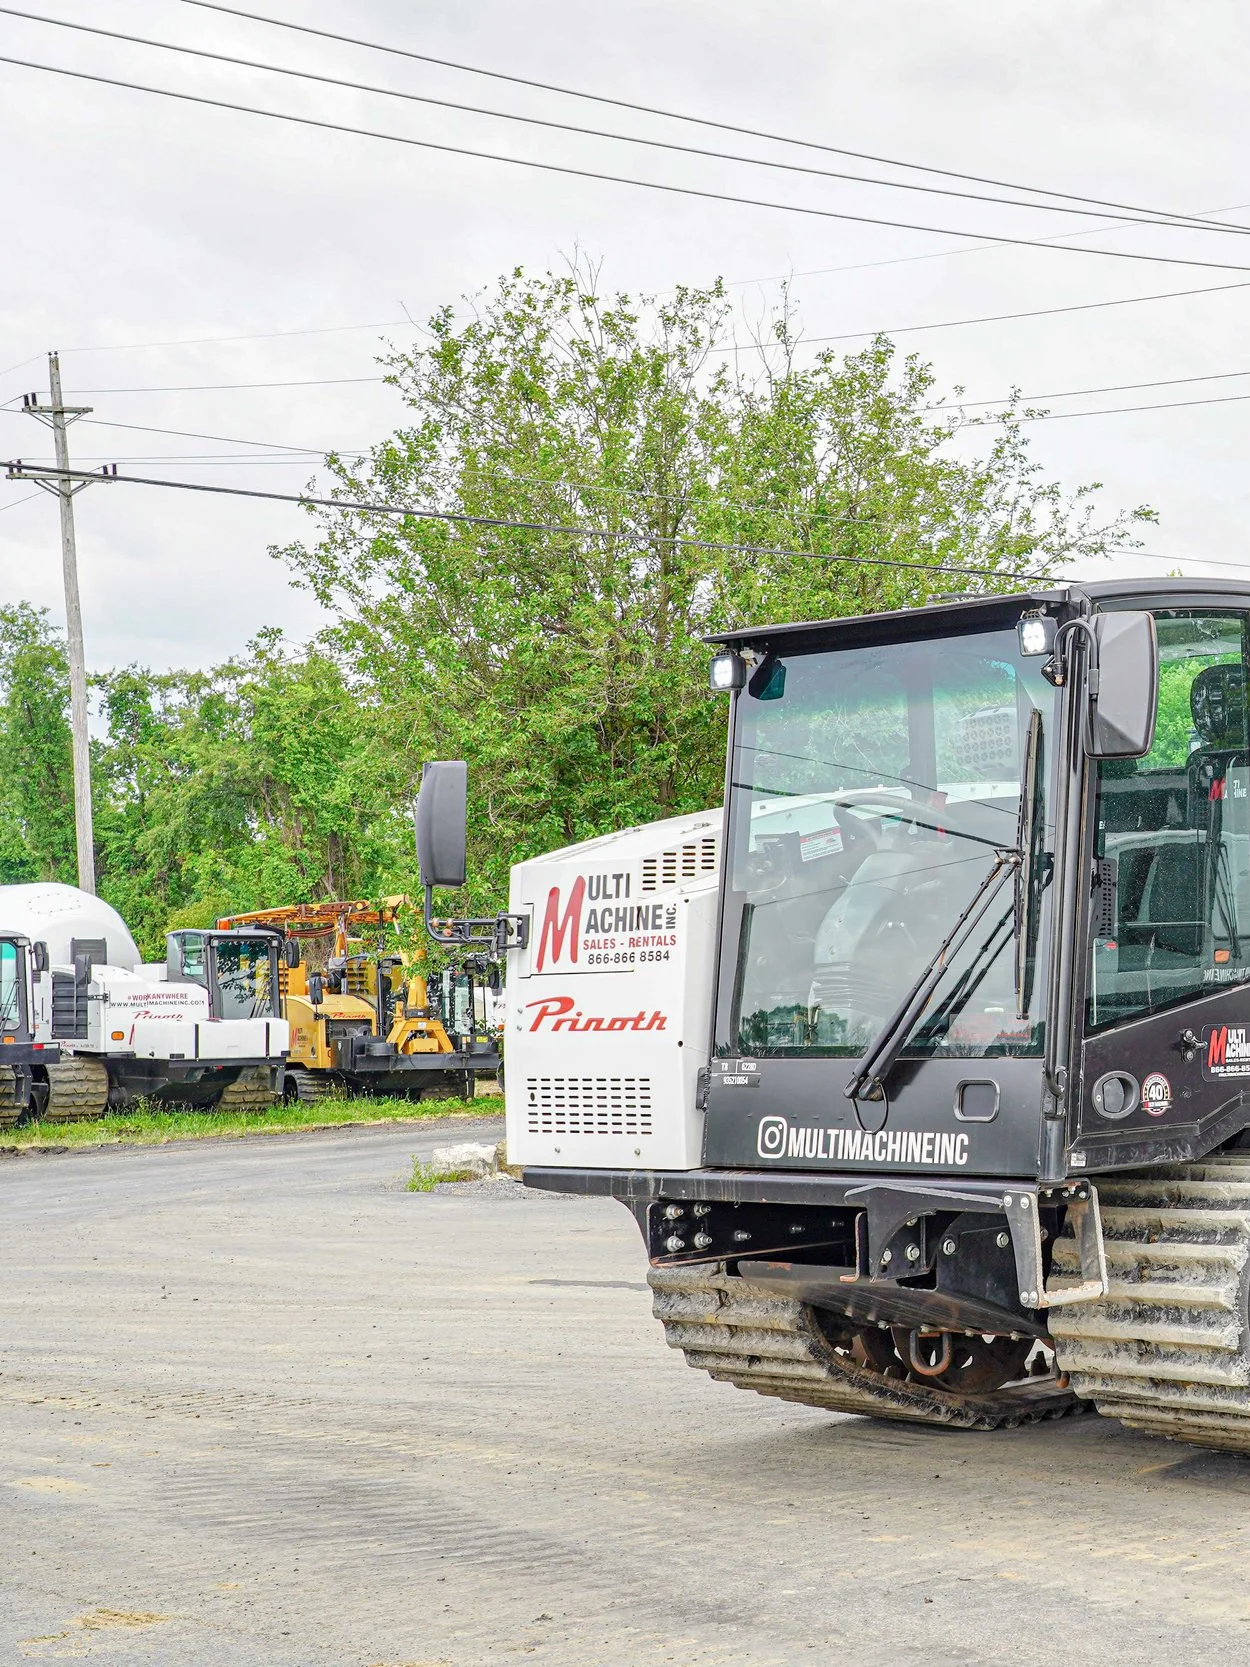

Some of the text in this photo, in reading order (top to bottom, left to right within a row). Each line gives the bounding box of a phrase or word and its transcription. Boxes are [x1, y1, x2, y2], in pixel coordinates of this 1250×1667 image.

[665, 903, 677, 930] INC.
[583, 934, 677, 951] SALES RENTALS
[132, 1010, 183, 1019] Prinoth
[332, 1011, 367, 1019] Prinoth
[525, 996, 668, 1032] Prinoth
[1149, 1084, 1164, 1101] 40
[787, 1126, 969, 1165] MULTIMACHINEINC
